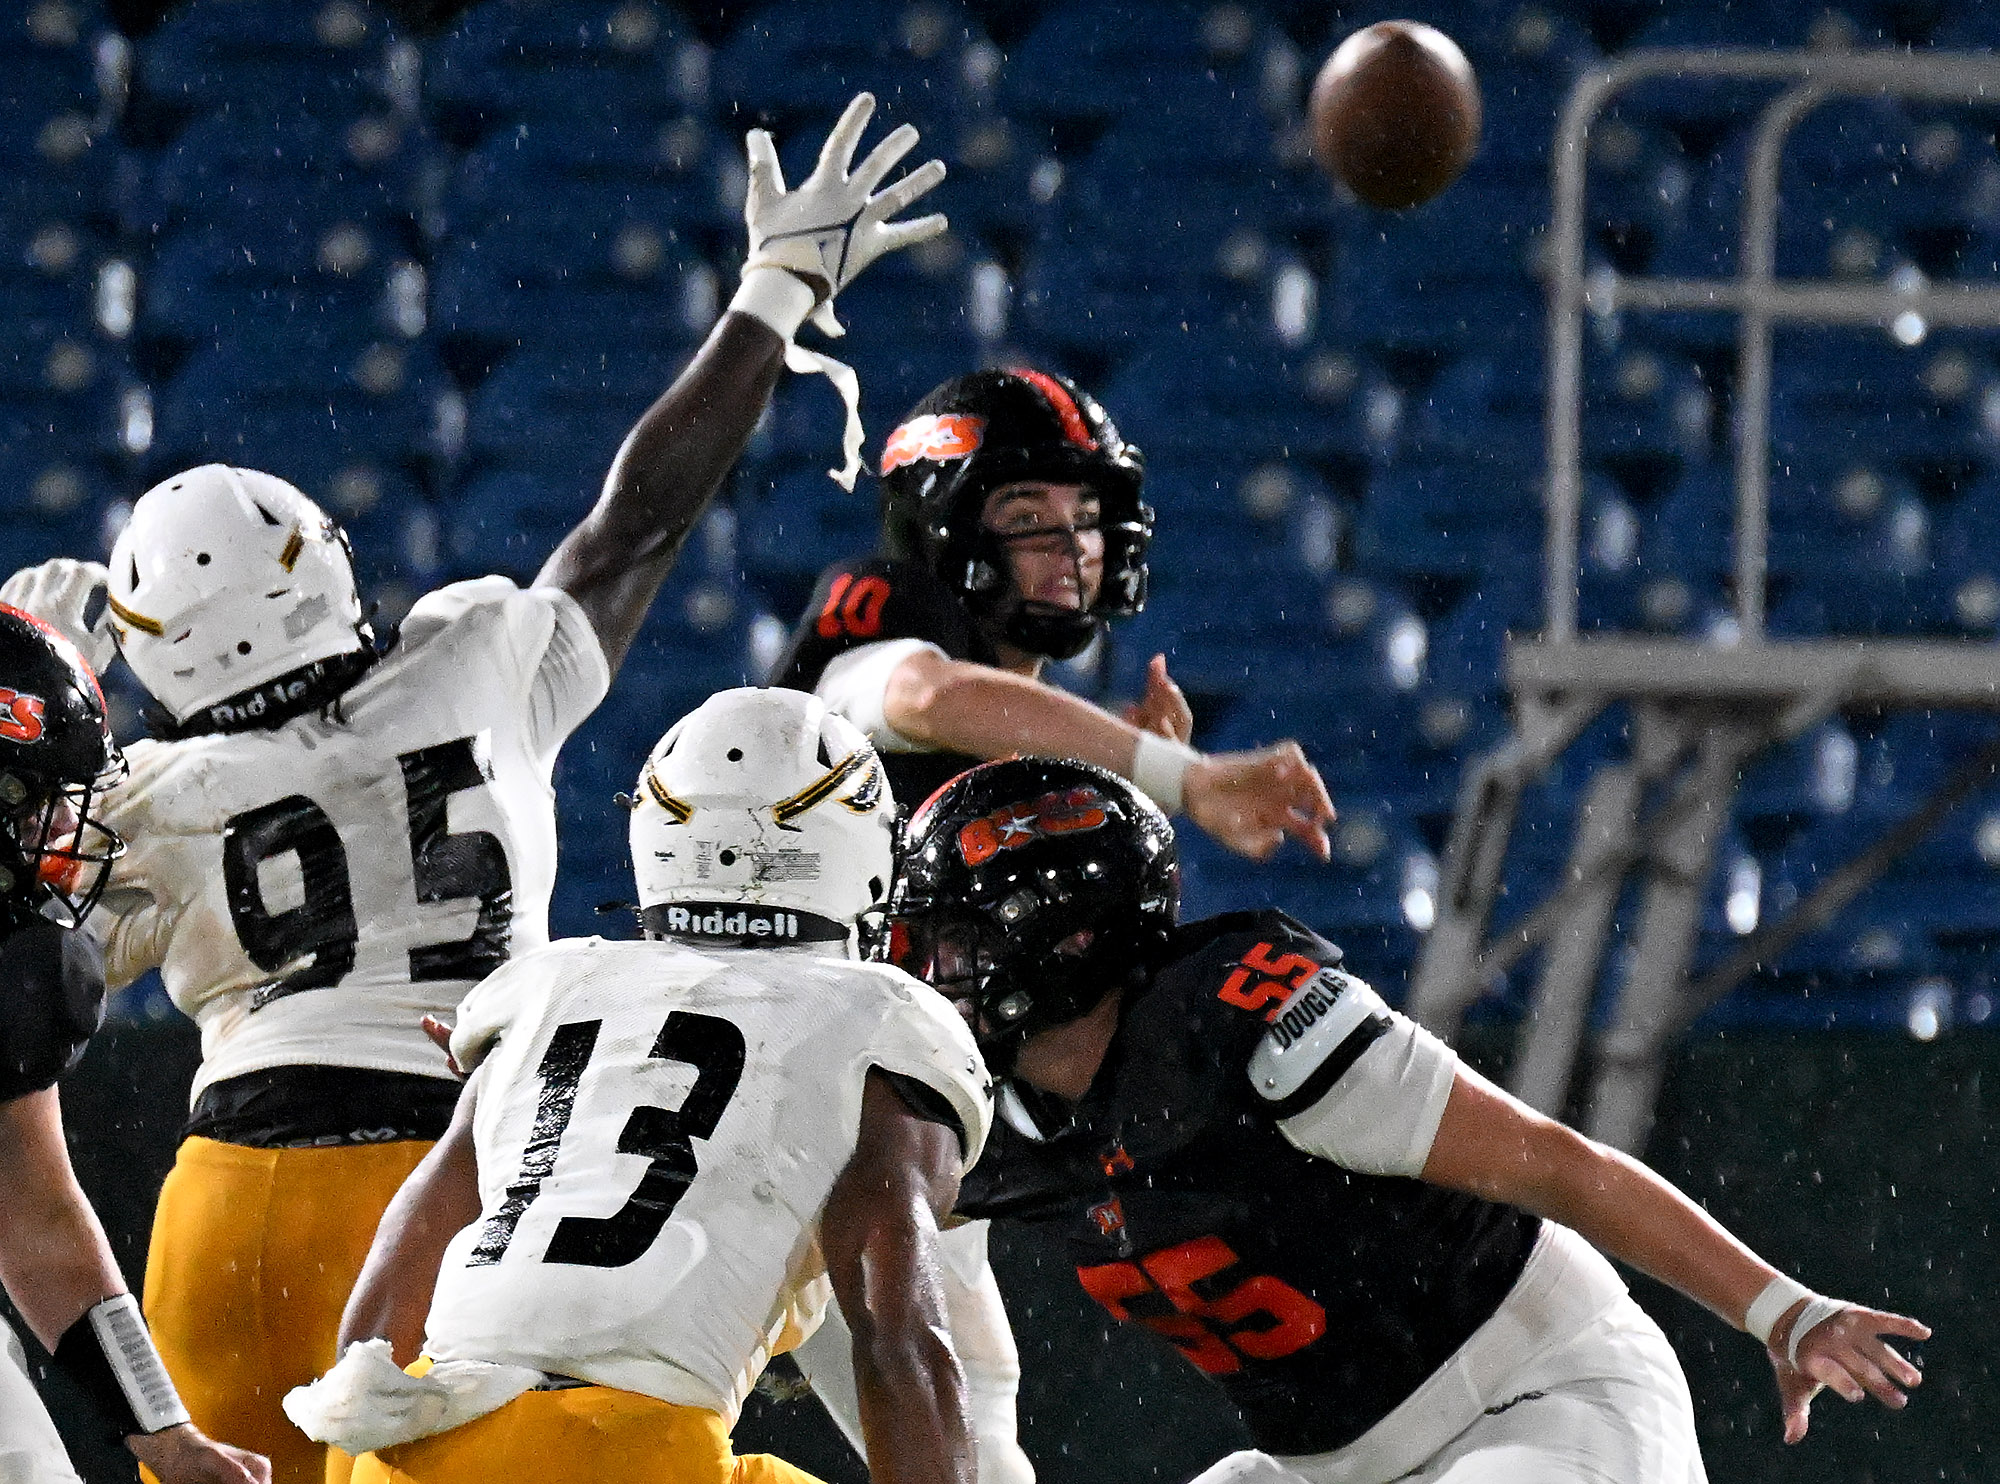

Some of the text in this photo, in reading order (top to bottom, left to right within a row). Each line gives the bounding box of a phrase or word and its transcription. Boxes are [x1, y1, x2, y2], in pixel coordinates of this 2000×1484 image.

[818, 572, 891, 638] 10
[222, 733, 512, 1015] 95
[667, 906, 799, 938] Riddell
[1217, 942, 1321, 1023] 55
[1268, 971, 1348, 1052] DOUGLAS
[466, 1011, 747, 1268] 13
[1077, 1235, 1327, 1375] 55
